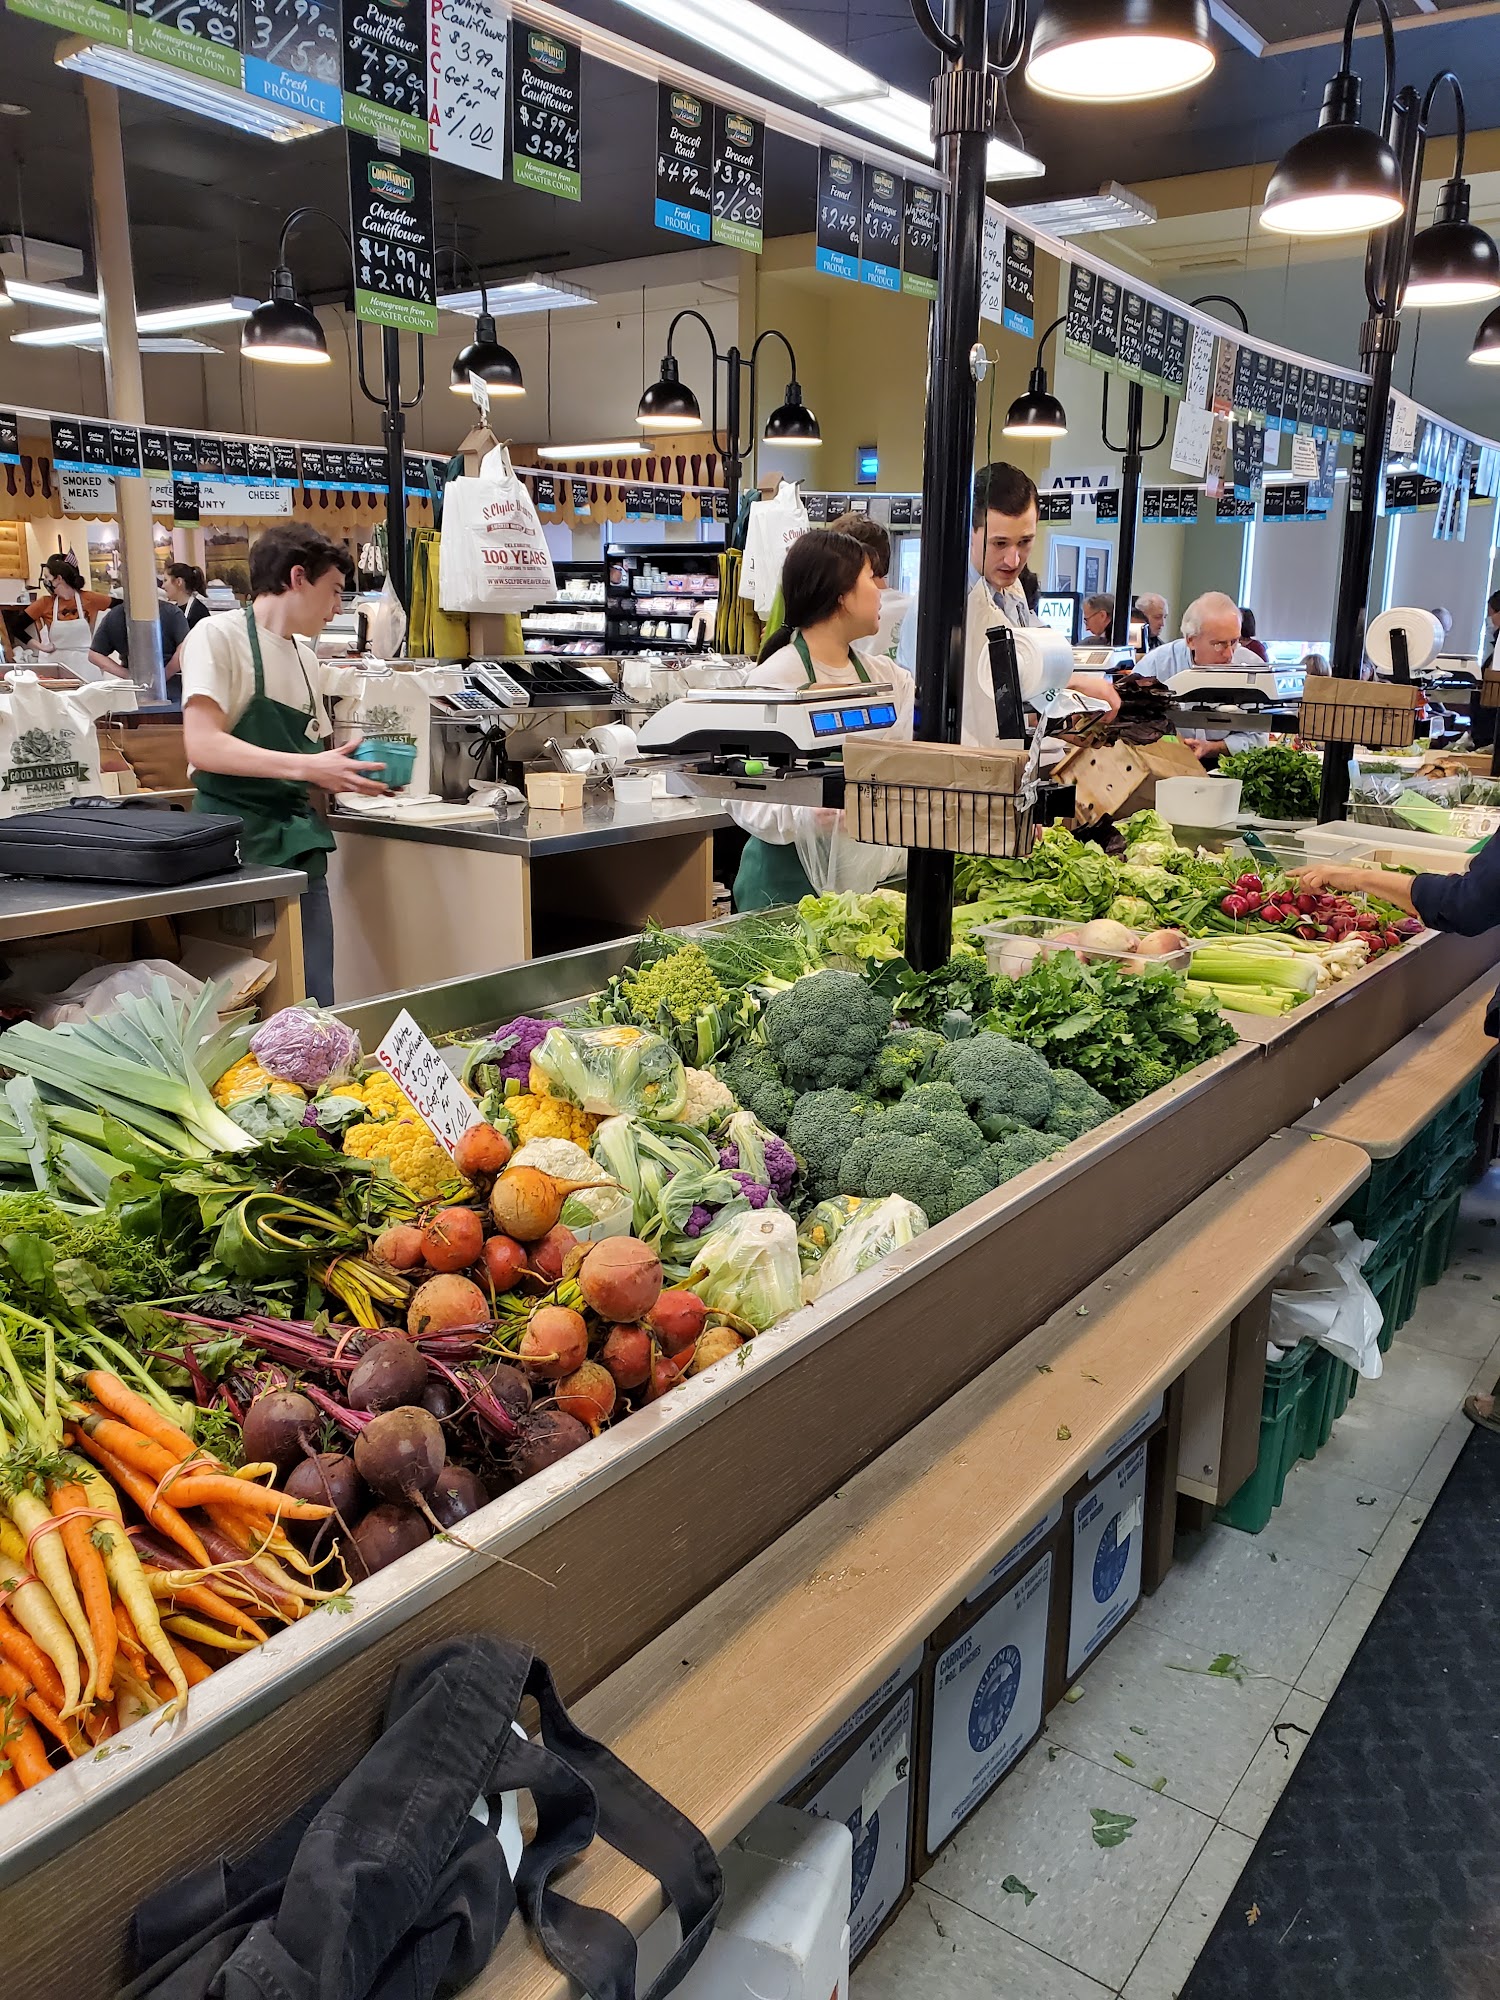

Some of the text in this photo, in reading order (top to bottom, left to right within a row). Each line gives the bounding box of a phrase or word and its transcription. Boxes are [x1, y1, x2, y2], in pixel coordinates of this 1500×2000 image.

[77, 15, 123, 38] COUNTY
[367, 4, 406, 32] Purple
[442, 4, 508, 43] Cauliflower
[152, 27, 225, 61] Homegrown from
[353, 16, 419, 53] Cauliflower
[139, 36, 237, 77] LANCASTER COUNTY
[280, 71, 308, 93] Fresh
[406, 72, 426, 94] ea
[445, 66, 500, 100] Get 2nd
[491, 67, 505, 80] ea
[521, 68, 573, 99] Romanesco
[263, 80, 326, 115] PRODUCE
[356, 73, 405, 106] 2.99
[456, 92, 481, 109] For
[521, 84, 574, 114] Cauliflower
[348, 110, 426, 146] LANCASTER COUNTY
[359, 102, 417, 131] Homegrown from
[519, 105, 566, 136] $5.99
[526, 134, 563, 161] 3.29
[669, 127, 702, 149] Broccoli
[674, 142, 696, 160] Raab
[725, 146, 753, 167] Broccoli
[525, 161, 571, 183] Homegrown from
[657, 156, 699, 184] $4.99
[713, 159, 762, 198] $3.99 ea
[516, 169, 579, 195] LANCASTER COUNTY
[690, 181, 712, 201] bunch
[830, 184, 851, 201] Fennel
[369, 202, 417, 227] Cheddar
[674, 207, 691, 221] Fresh
[821, 206, 857, 232] $2.49
[867, 198, 898, 217] Asparagus
[362, 215, 426, 245] Cauliflower
[664, 215, 701, 235] PRODUCE
[864, 213, 892, 239] $3.99
[741, 235, 761, 249] COUNTY
[359, 237, 417, 272] $4.99
[830, 252, 844, 265] Fresh
[823, 260, 852, 277] PRODUCE
[874, 265, 887, 276] Fresh
[1006, 256, 1033, 278] Green Celery
[360, 265, 417, 297] $2.99
[867, 272, 894, 288] PRODUCE
[360, 305, 435, 330] LANCASTER COUNTY
[369, 296, 426, 317] Homegrown from
[62, 476, 102, 486] SMOKED
[68, 488, 99, 498] MEATS
[248, 490, 280, 500] CHEESE
[490, 500, 515, 517] Clyde
[481, 549, 547, 566] 100 YEARS
[1041, 602, 1071, 618] ATM
[10, 764, 77, 782] GOOD HARVEST
[26, 781, 66, 794] FARMS
[391, 1026, 413, 1056] White
[379, 1050, 456, 1154] SPECIA
[426, 1086, 440, 1113] Get
[939, 1635, 973, 1676] CARROTS
